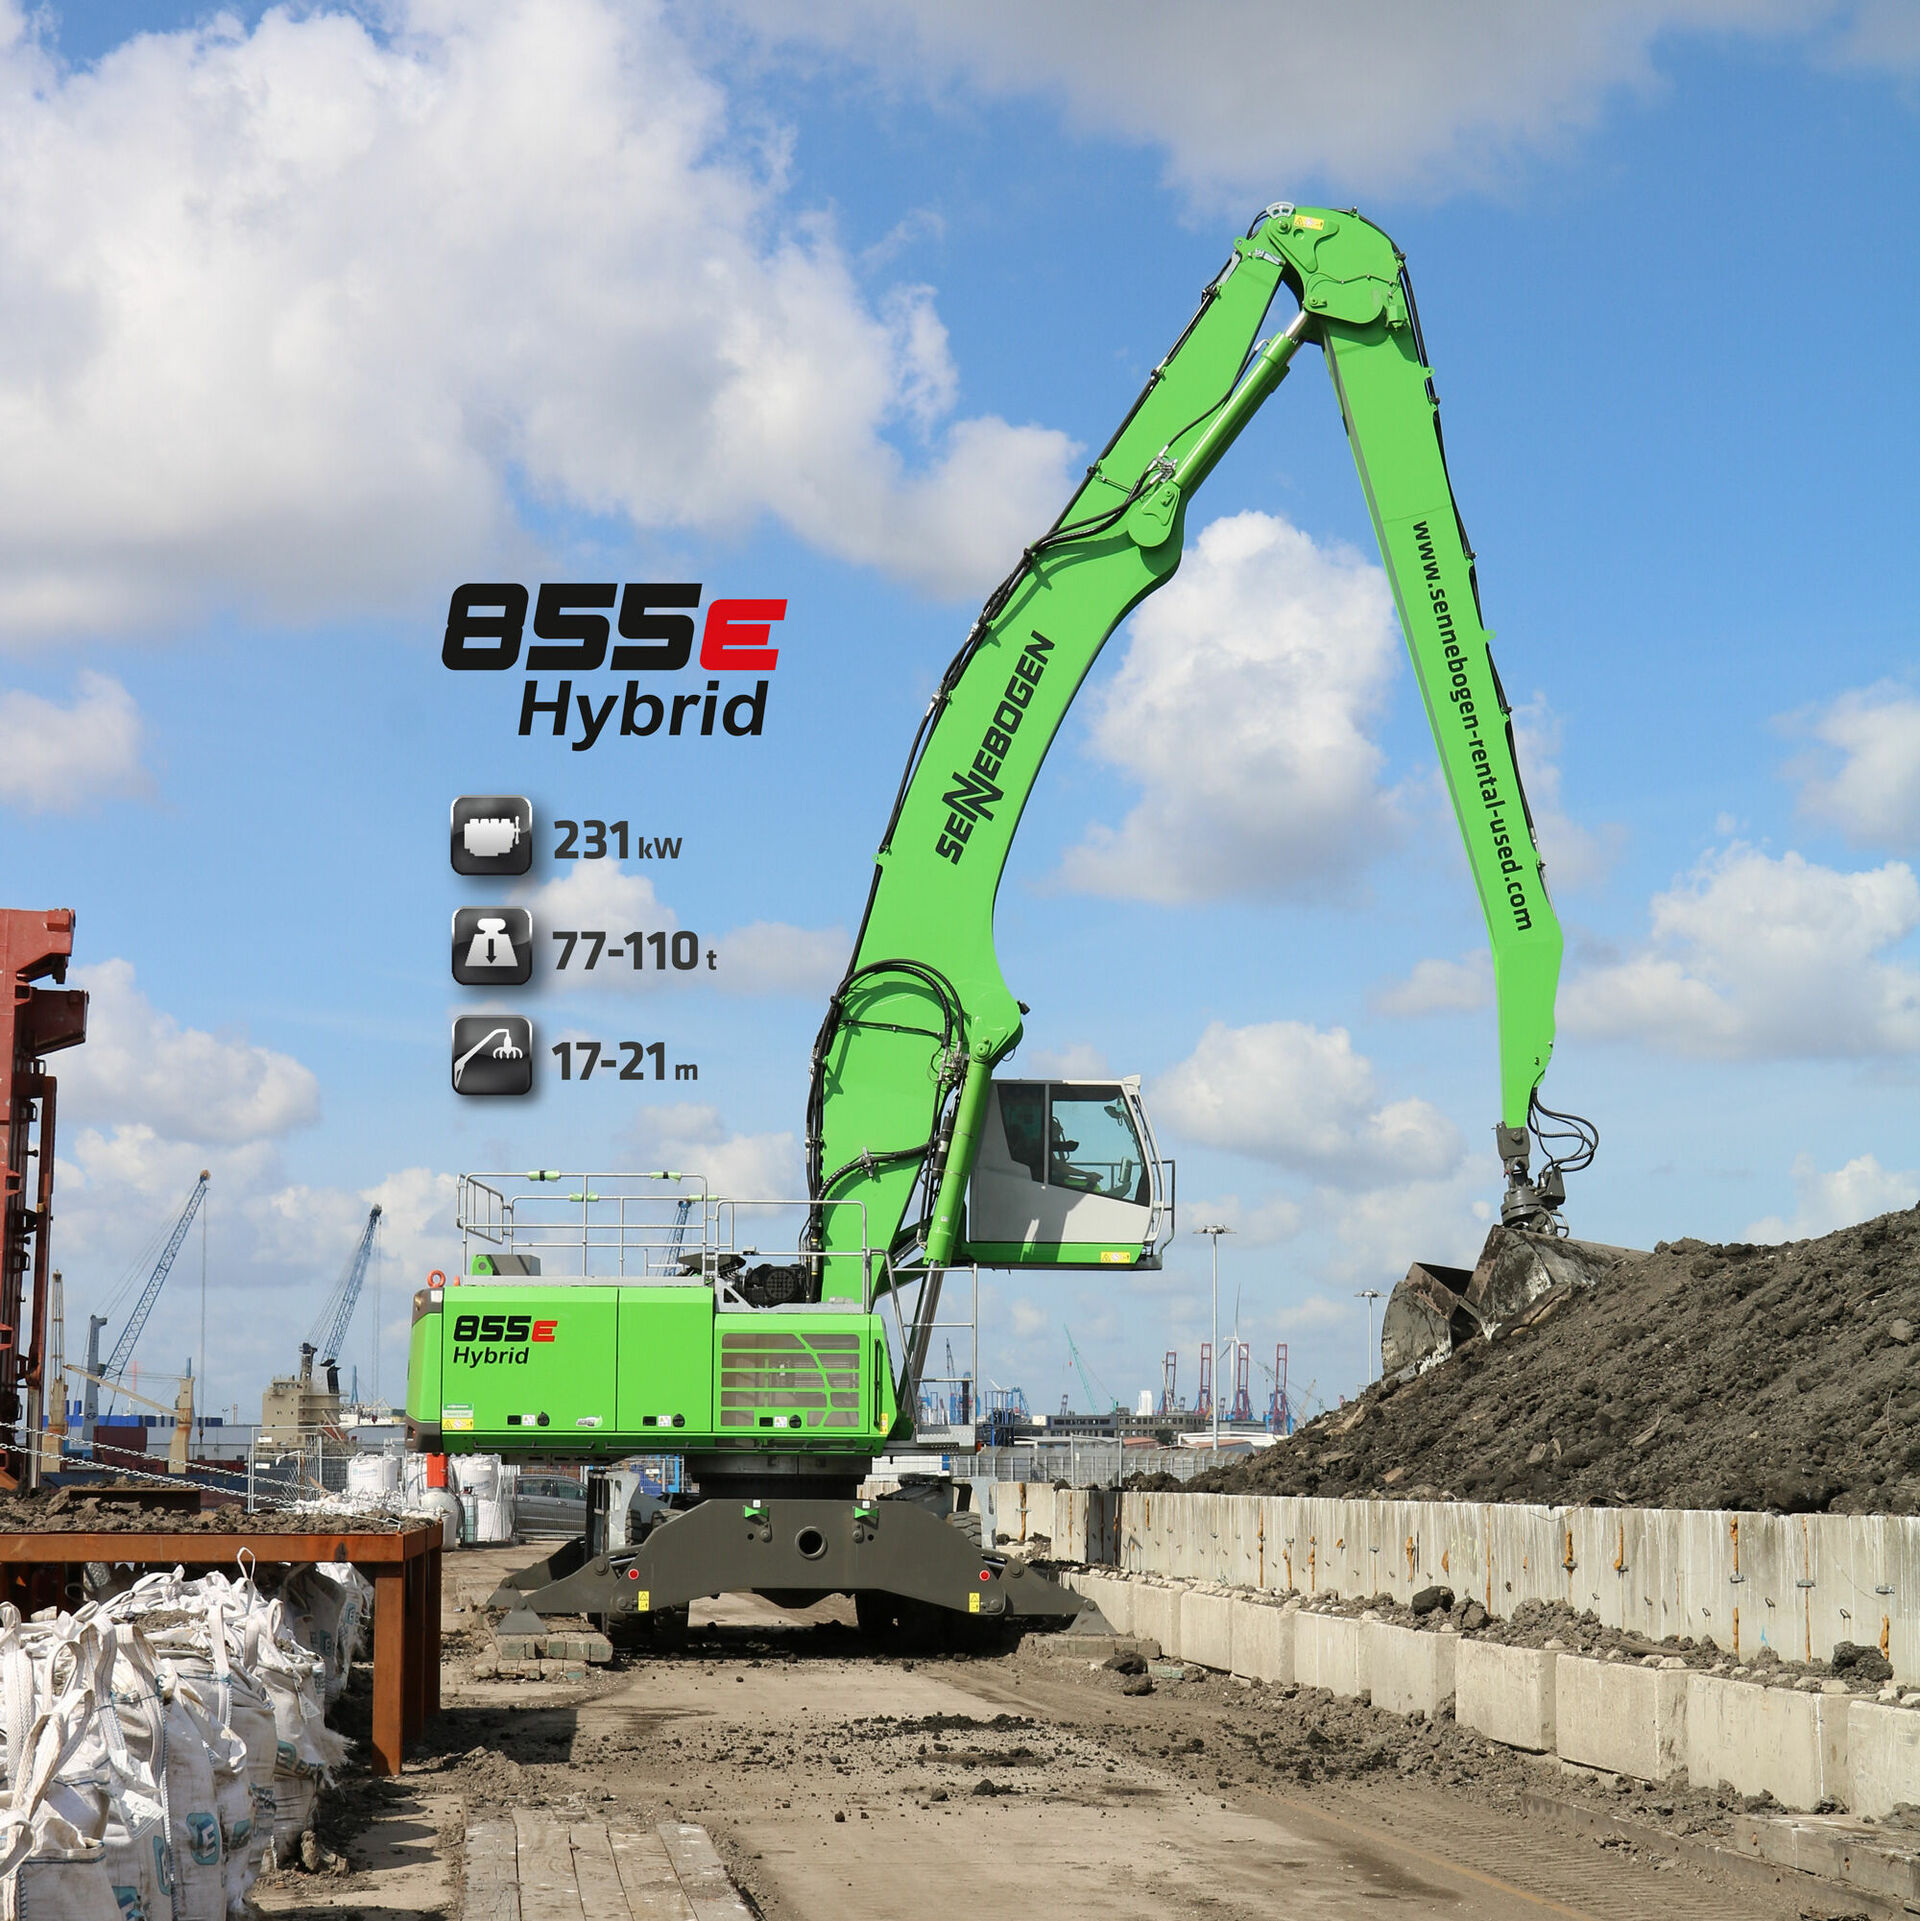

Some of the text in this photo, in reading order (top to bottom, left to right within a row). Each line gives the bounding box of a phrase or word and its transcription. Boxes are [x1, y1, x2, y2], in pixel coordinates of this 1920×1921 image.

[935, 630, 1056, 866] SENNEBOGEN
[1413, 521, 1532, 931] www.sennebogen-rental-used.com
[453, 1347, 530, 1368] Hybrid
[454, 1315, 558, 1343] 855E
